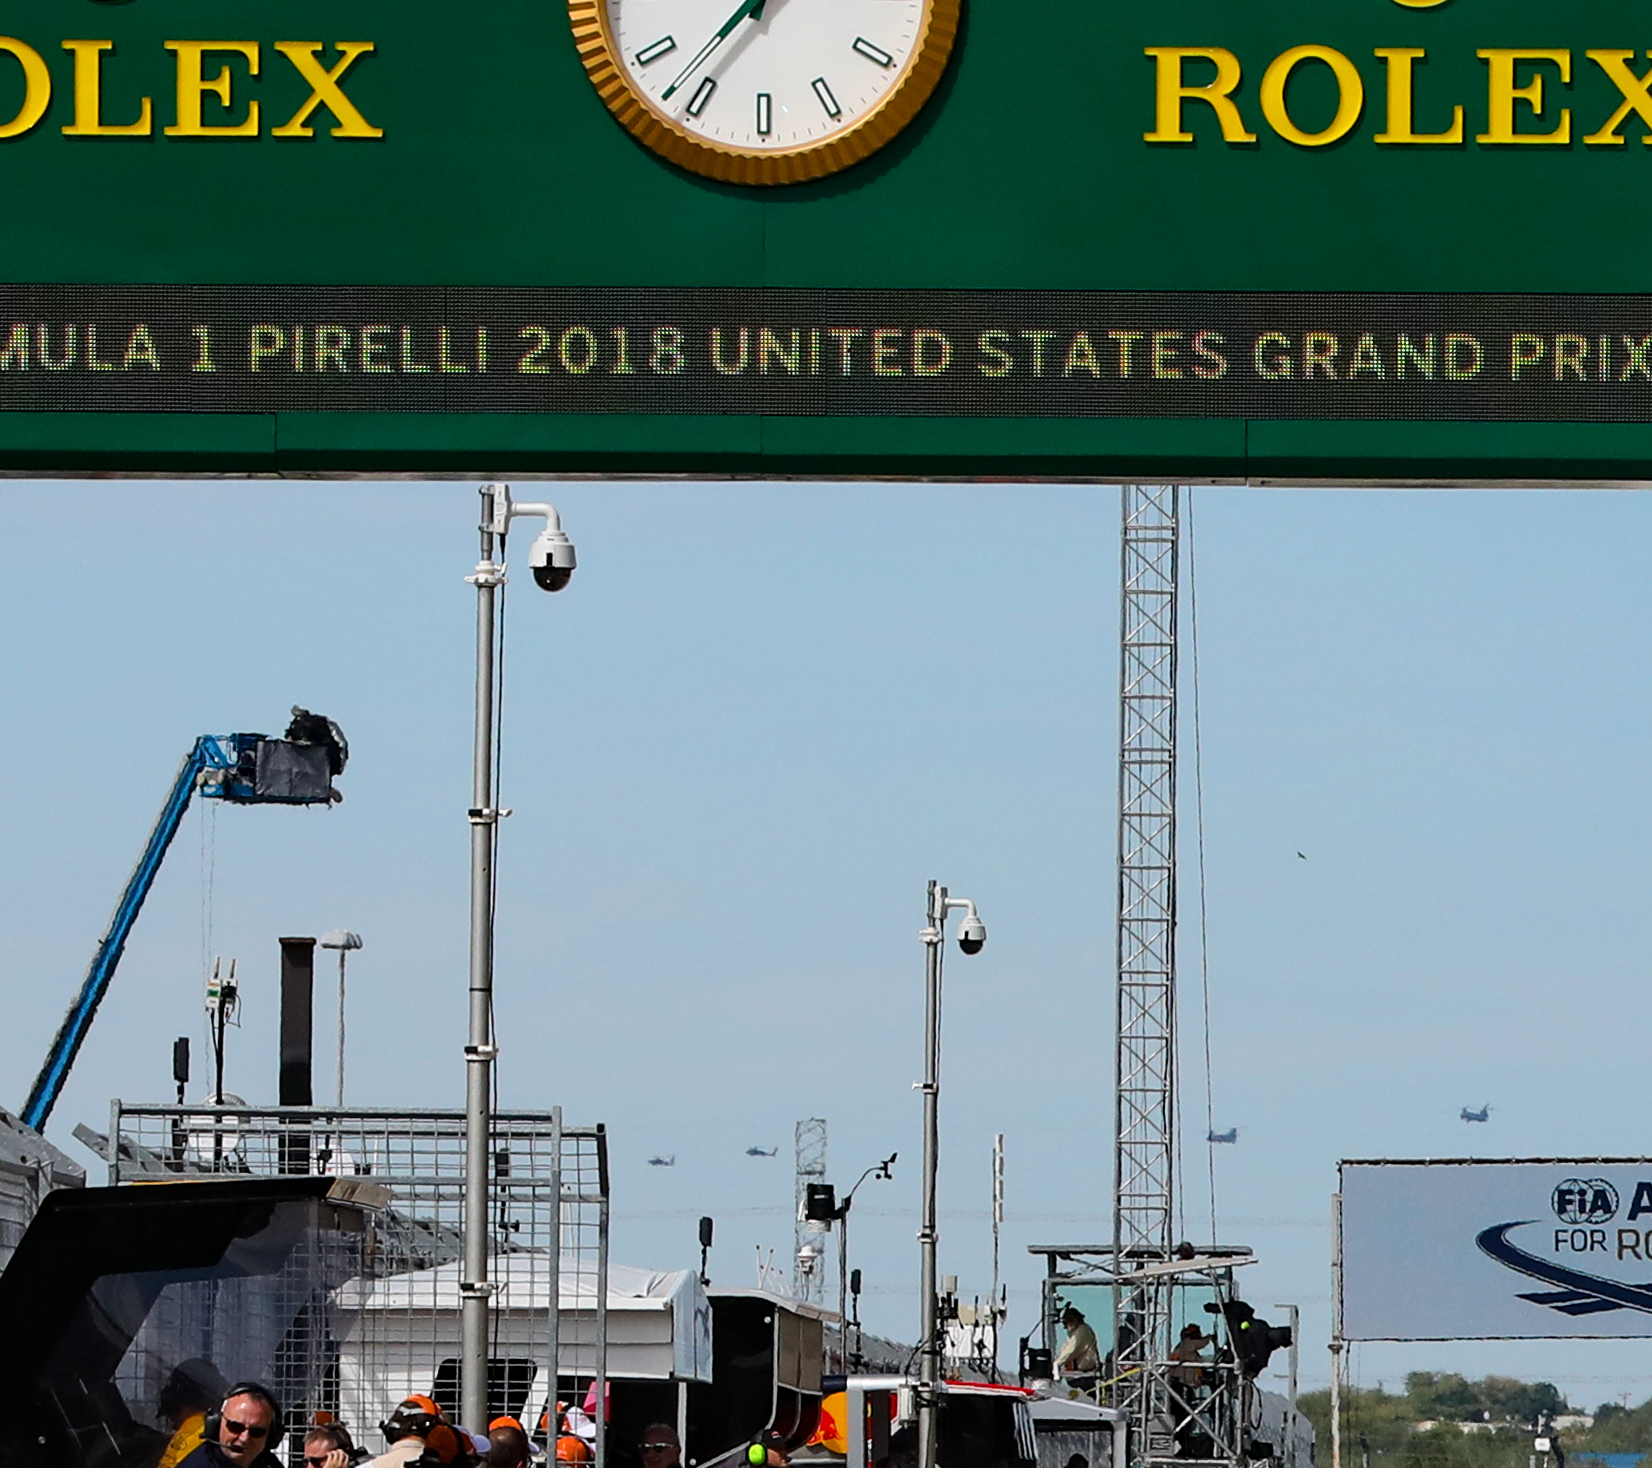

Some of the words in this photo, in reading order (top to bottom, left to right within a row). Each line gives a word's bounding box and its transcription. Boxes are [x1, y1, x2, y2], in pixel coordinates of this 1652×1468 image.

[191, 324, 216, 373] 1
[250, 324, 488, 375] PIRELLI
[516, 326, 685, 375] 2018
[710, 327, 953, 377] UNITED
[977, 329, 1228, 380] STATES
[1253, 330, 1485, 382] GRAND
[1554, 1228, 1608, 1253] FOR
